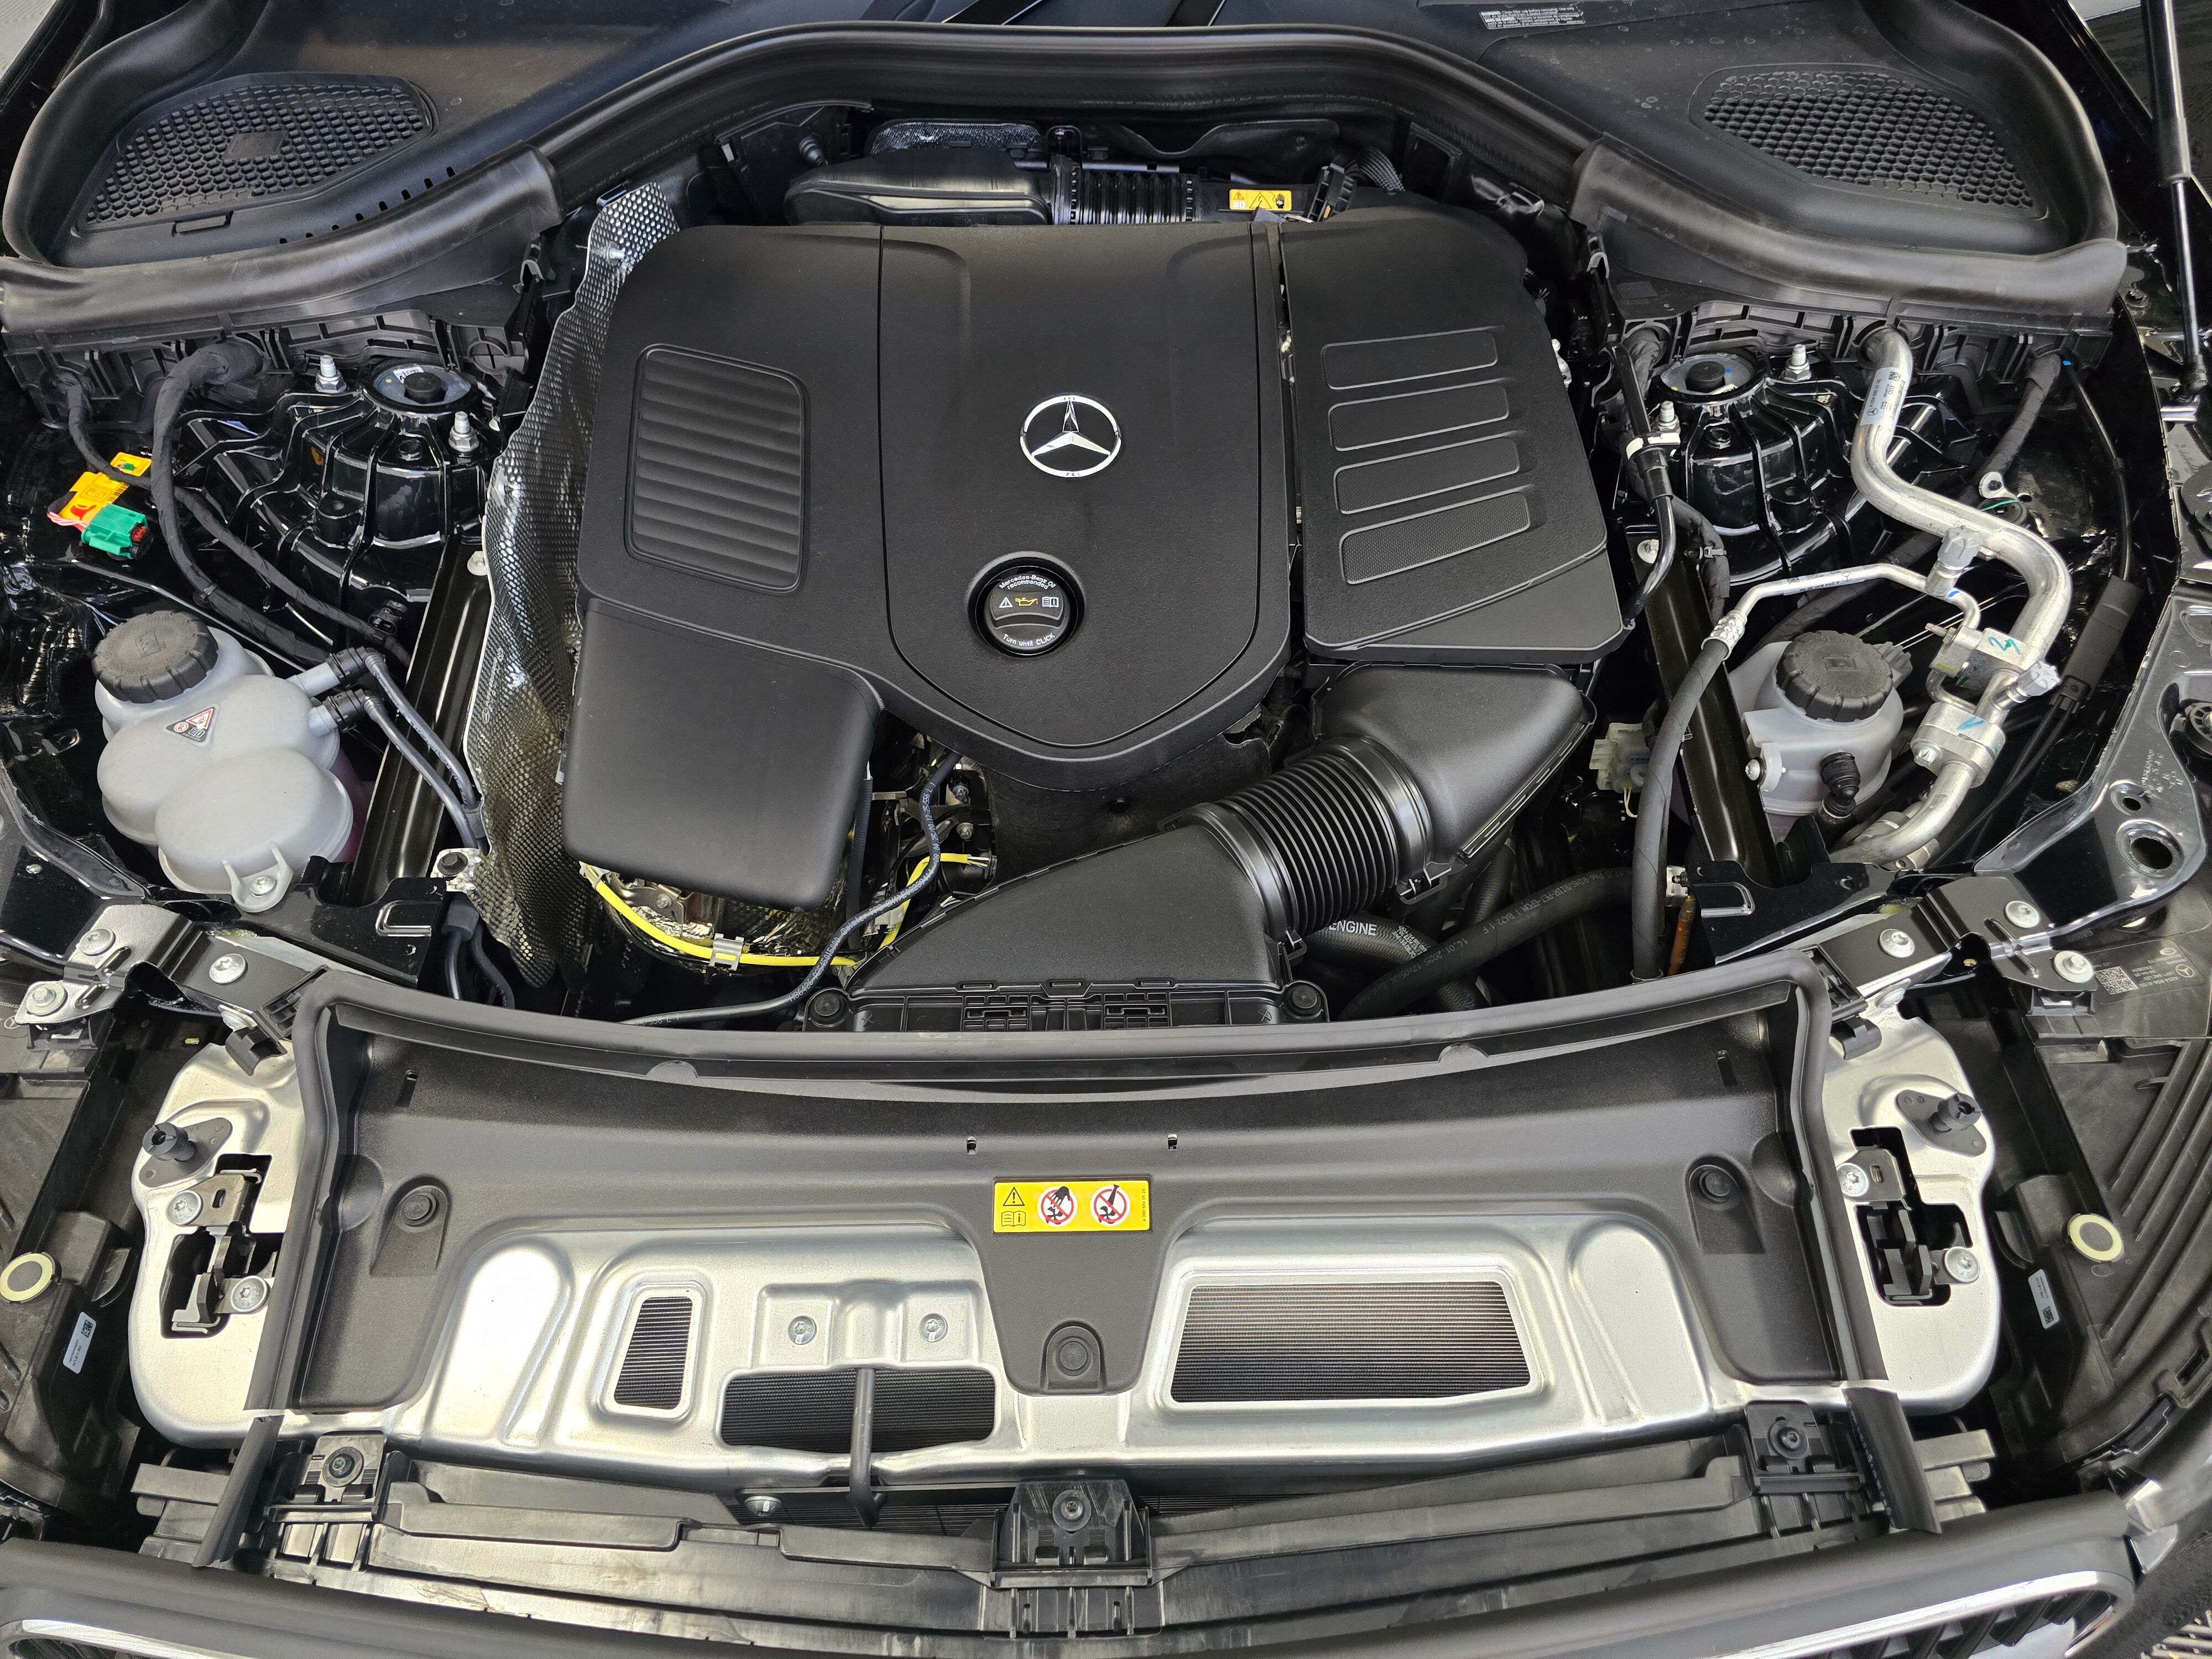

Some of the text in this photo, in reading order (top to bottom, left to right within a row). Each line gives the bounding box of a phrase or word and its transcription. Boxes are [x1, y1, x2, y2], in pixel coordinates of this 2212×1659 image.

[999, 575, 1047, 589] Mercedes-Benz
[1006, 579, 1049, 590] recommended
[1003, 634, 1017, 645] Turn
[1036, 633, 1056, 645] CLICK
[1328, 919, 1378, 937] ENGINE
[1480, 924, 1489, 935] F
